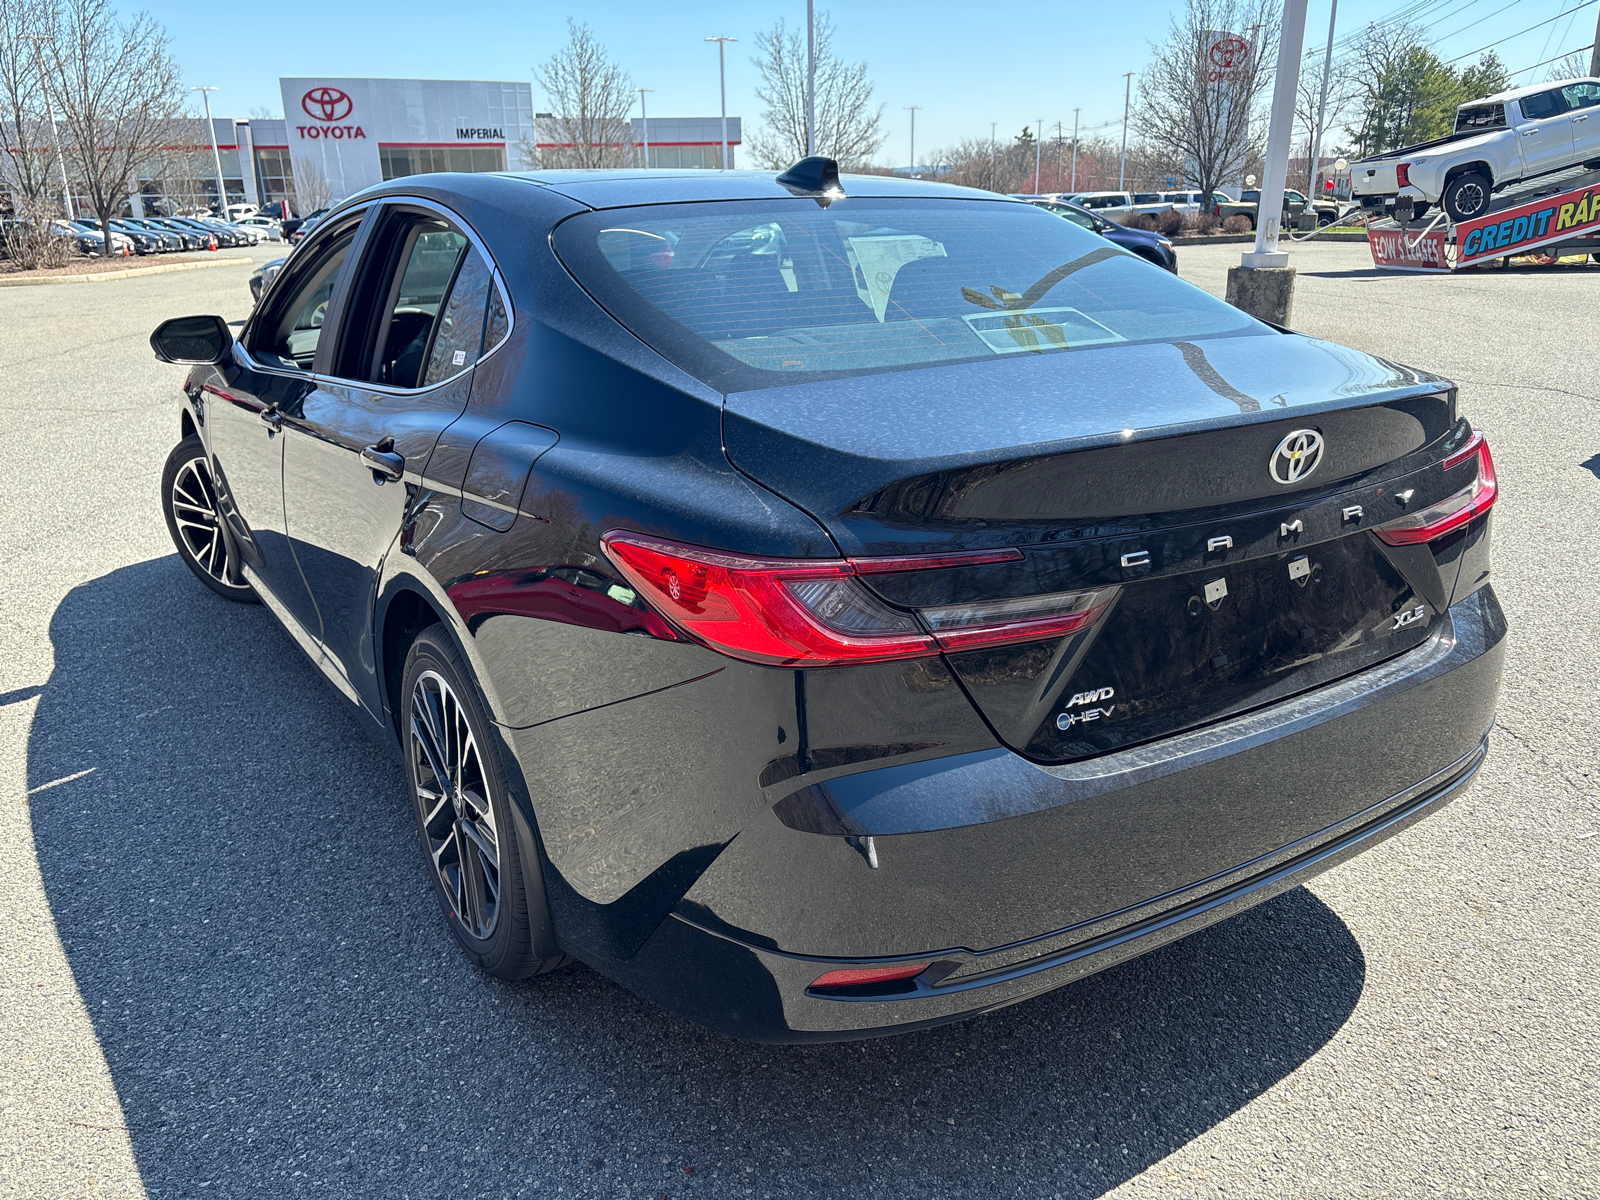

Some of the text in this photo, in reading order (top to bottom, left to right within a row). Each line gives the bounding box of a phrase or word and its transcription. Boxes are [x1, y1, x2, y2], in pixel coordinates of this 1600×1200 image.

[296, 126, 366, 139] TOYOTA
[456, 128, 505, 139] IMPERIAL
[1463, 207, 1556, 257] CREDIT
[1375, 235, 1439, 263] LOW $ LEASES
[1120, 488, 1415, 568] CAMRY
[1392, 604, 1425, 630] XLE
[1065, 686, 1115, 709] AWD
[1070, 703, 1116, 725] HEV
